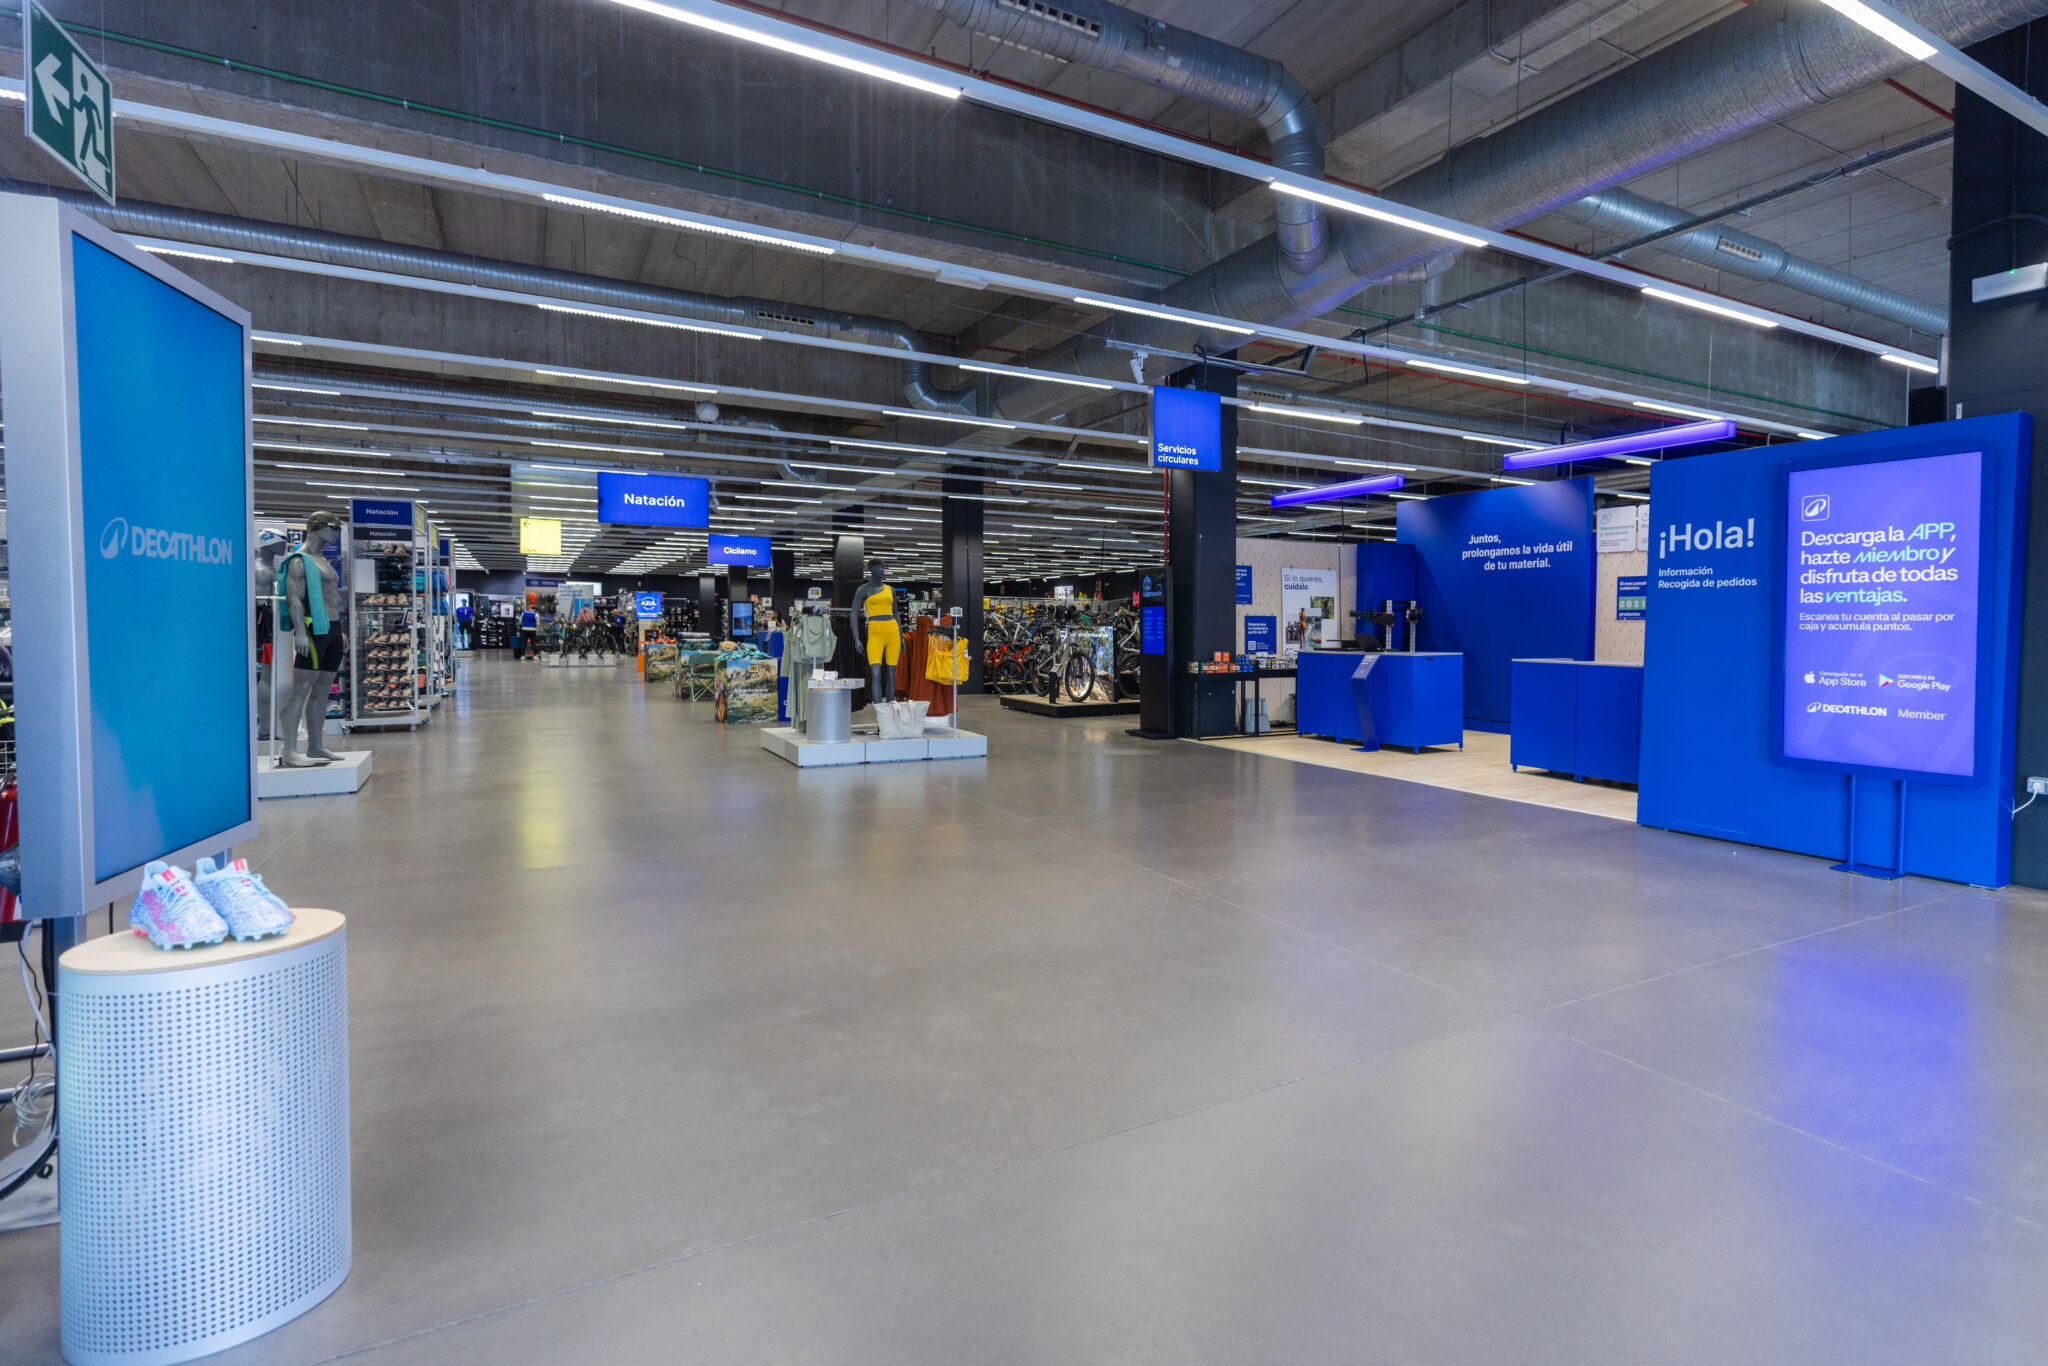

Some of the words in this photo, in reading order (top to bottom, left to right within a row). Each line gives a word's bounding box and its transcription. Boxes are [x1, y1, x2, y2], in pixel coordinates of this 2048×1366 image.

[1158, 443, 1197, 455] Servicios
[1158, 454, 1199, 465] circulares
[624, 493, 685, 508] Natación
[366, 508, 399, 516] Natación
[1468, 534, 1502, 545] Juntos,
[1659, 518, 1755, 559] ¡Hola!
[1801, 530, 1886, 547] Descarga
[1888, 525, 1905, 542] la
[1907, 522, 1957, 543] APP,
[131, 525, 232, 566] DECATHLON
[723, 546, 757, 556] Ciclismo
[1462, 546, 1521, 560] prolongamos
[1522, 545, 1531, 555] la
[1533, 543, 1554, 554] vida
[1556, 541, 1573, 552] útil
[1801, 550, 1851, 565] hazte
[1852, 545, 1940, 564] miembro
[1939, 547, 1957, 564] y
[1484, 561, 1496, 571] de
[1497, 561, 1507, 570] tu
[1509, 558, 1551, 569] material.
[1658, 566, 1713, 577] Información
[1800, 568, 1870, 584] disfruta
[1871, 566, 1897, 582] de
[1899, 565, 1959, 582] todas
[1299, 576, 1324, 584] quieres,
[1658, 579, 1700, 590] Recogida
[1702, 579, 1715, 588] de
[1716, 577, 1758, 589] pedidos
[1284, 583, 1309, 591] cuídalo
[1800, 588, 1824, 604] las
[1825, 587, 1908, 606] ventajas.
[1799, 612, 1839, 621] Escanea
[1841, 612, 1851, 621] tu
[1853, 613, 1889, 621] cuenta
[1891, 612, 1900, 621] al
[1902, 613, 1933, 622] pasar
[1935, 613, 1955, 622] por
[1799, 622, 1819, 632] caja
[1820, 624, 1826, 632] y
[1827, 622, 1871, 631] acumula
[1873, 623, 1913, 632] puntos.
[1818, 677, 1843, 687] App
[1844, 678, 1867, 687] Store
[1897, 679, 1931, 691] Google
[1931, 682, 1951, 692] Play
[1822, 703, 1888, 717] DECATHLON
[1897, 709, 1947, 721] Member
